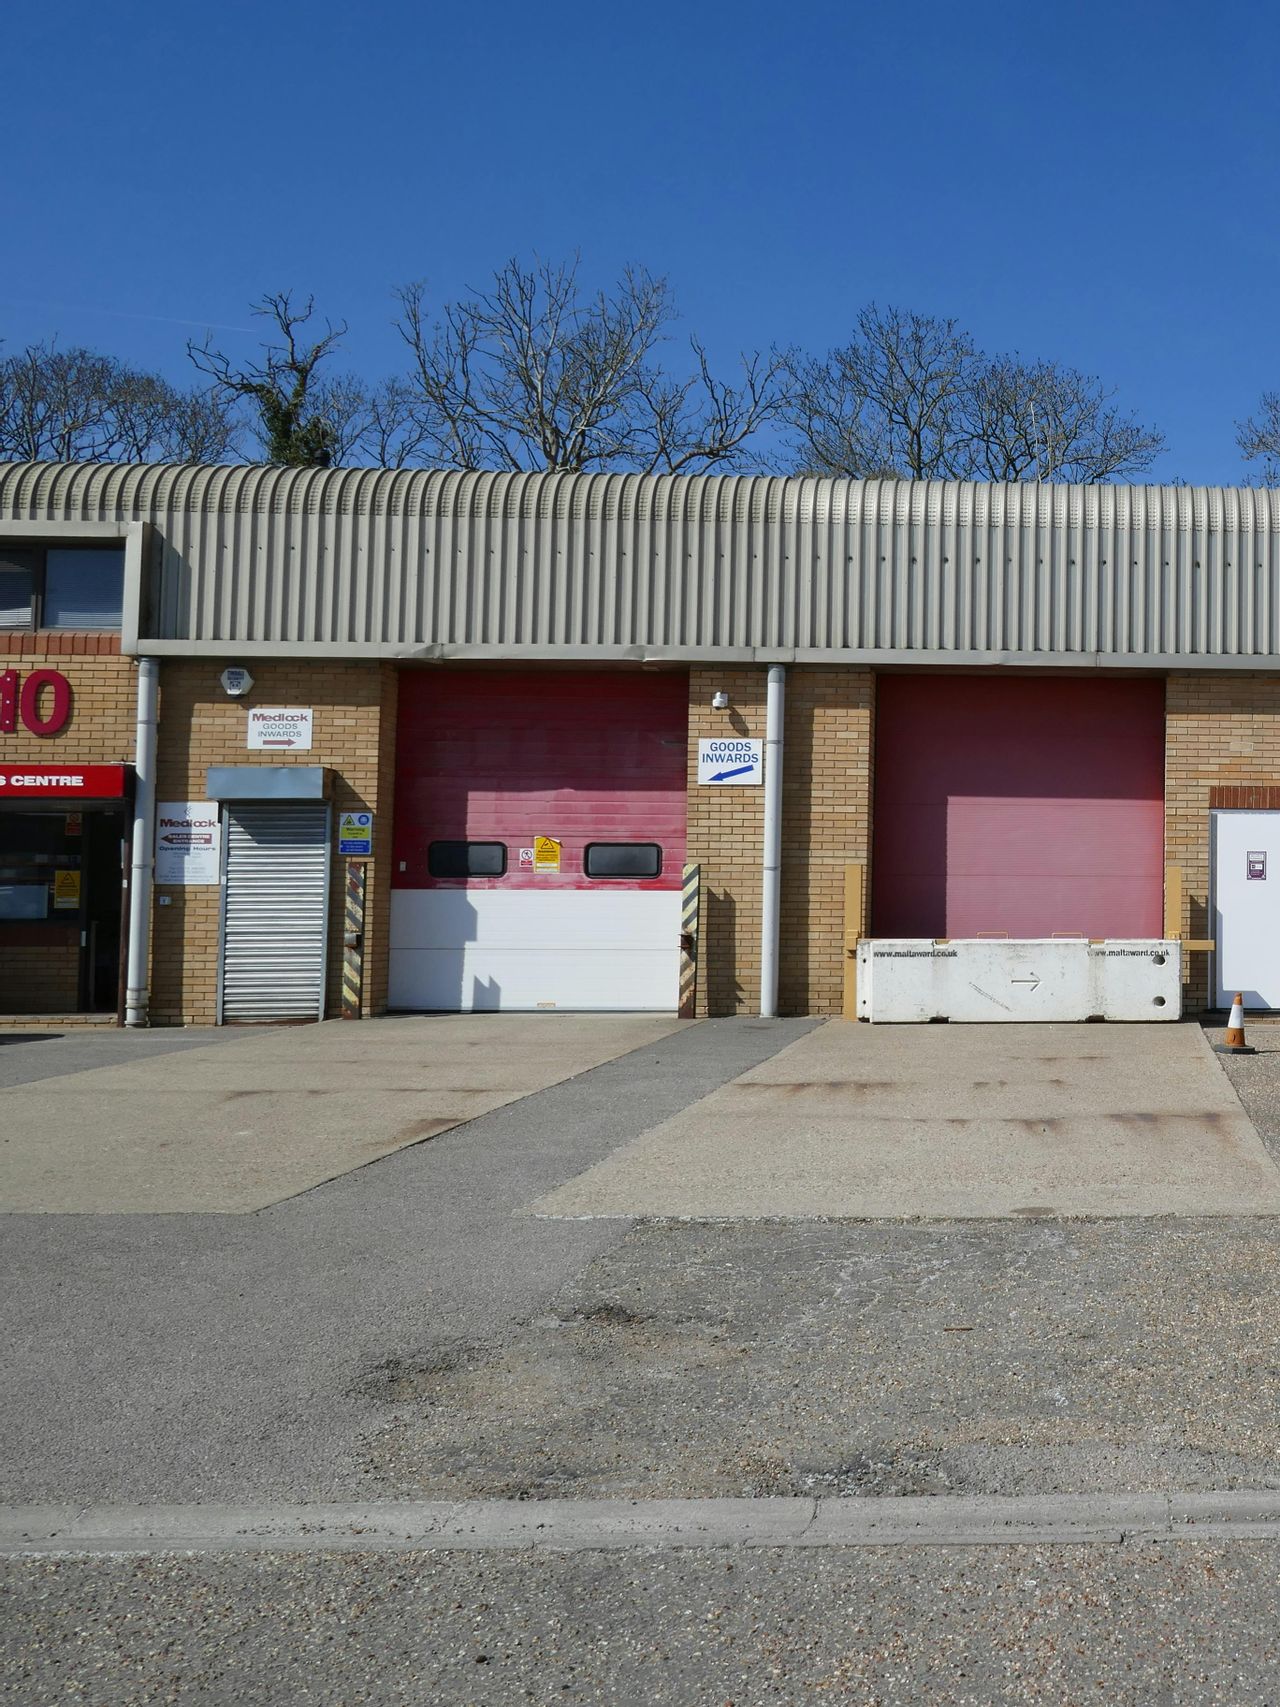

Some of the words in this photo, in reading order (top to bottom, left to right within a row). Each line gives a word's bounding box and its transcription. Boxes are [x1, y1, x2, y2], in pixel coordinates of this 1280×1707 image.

[0, 669, 70, 735] 10
[252, 713, 308, 722] Medlock
[710, 742, 752, 752] GOODS
[702, 754, 758, 763] INWARDS
[10, 775, 84, 786] CENTRE
[160, 819, 216, 827] Medlock
